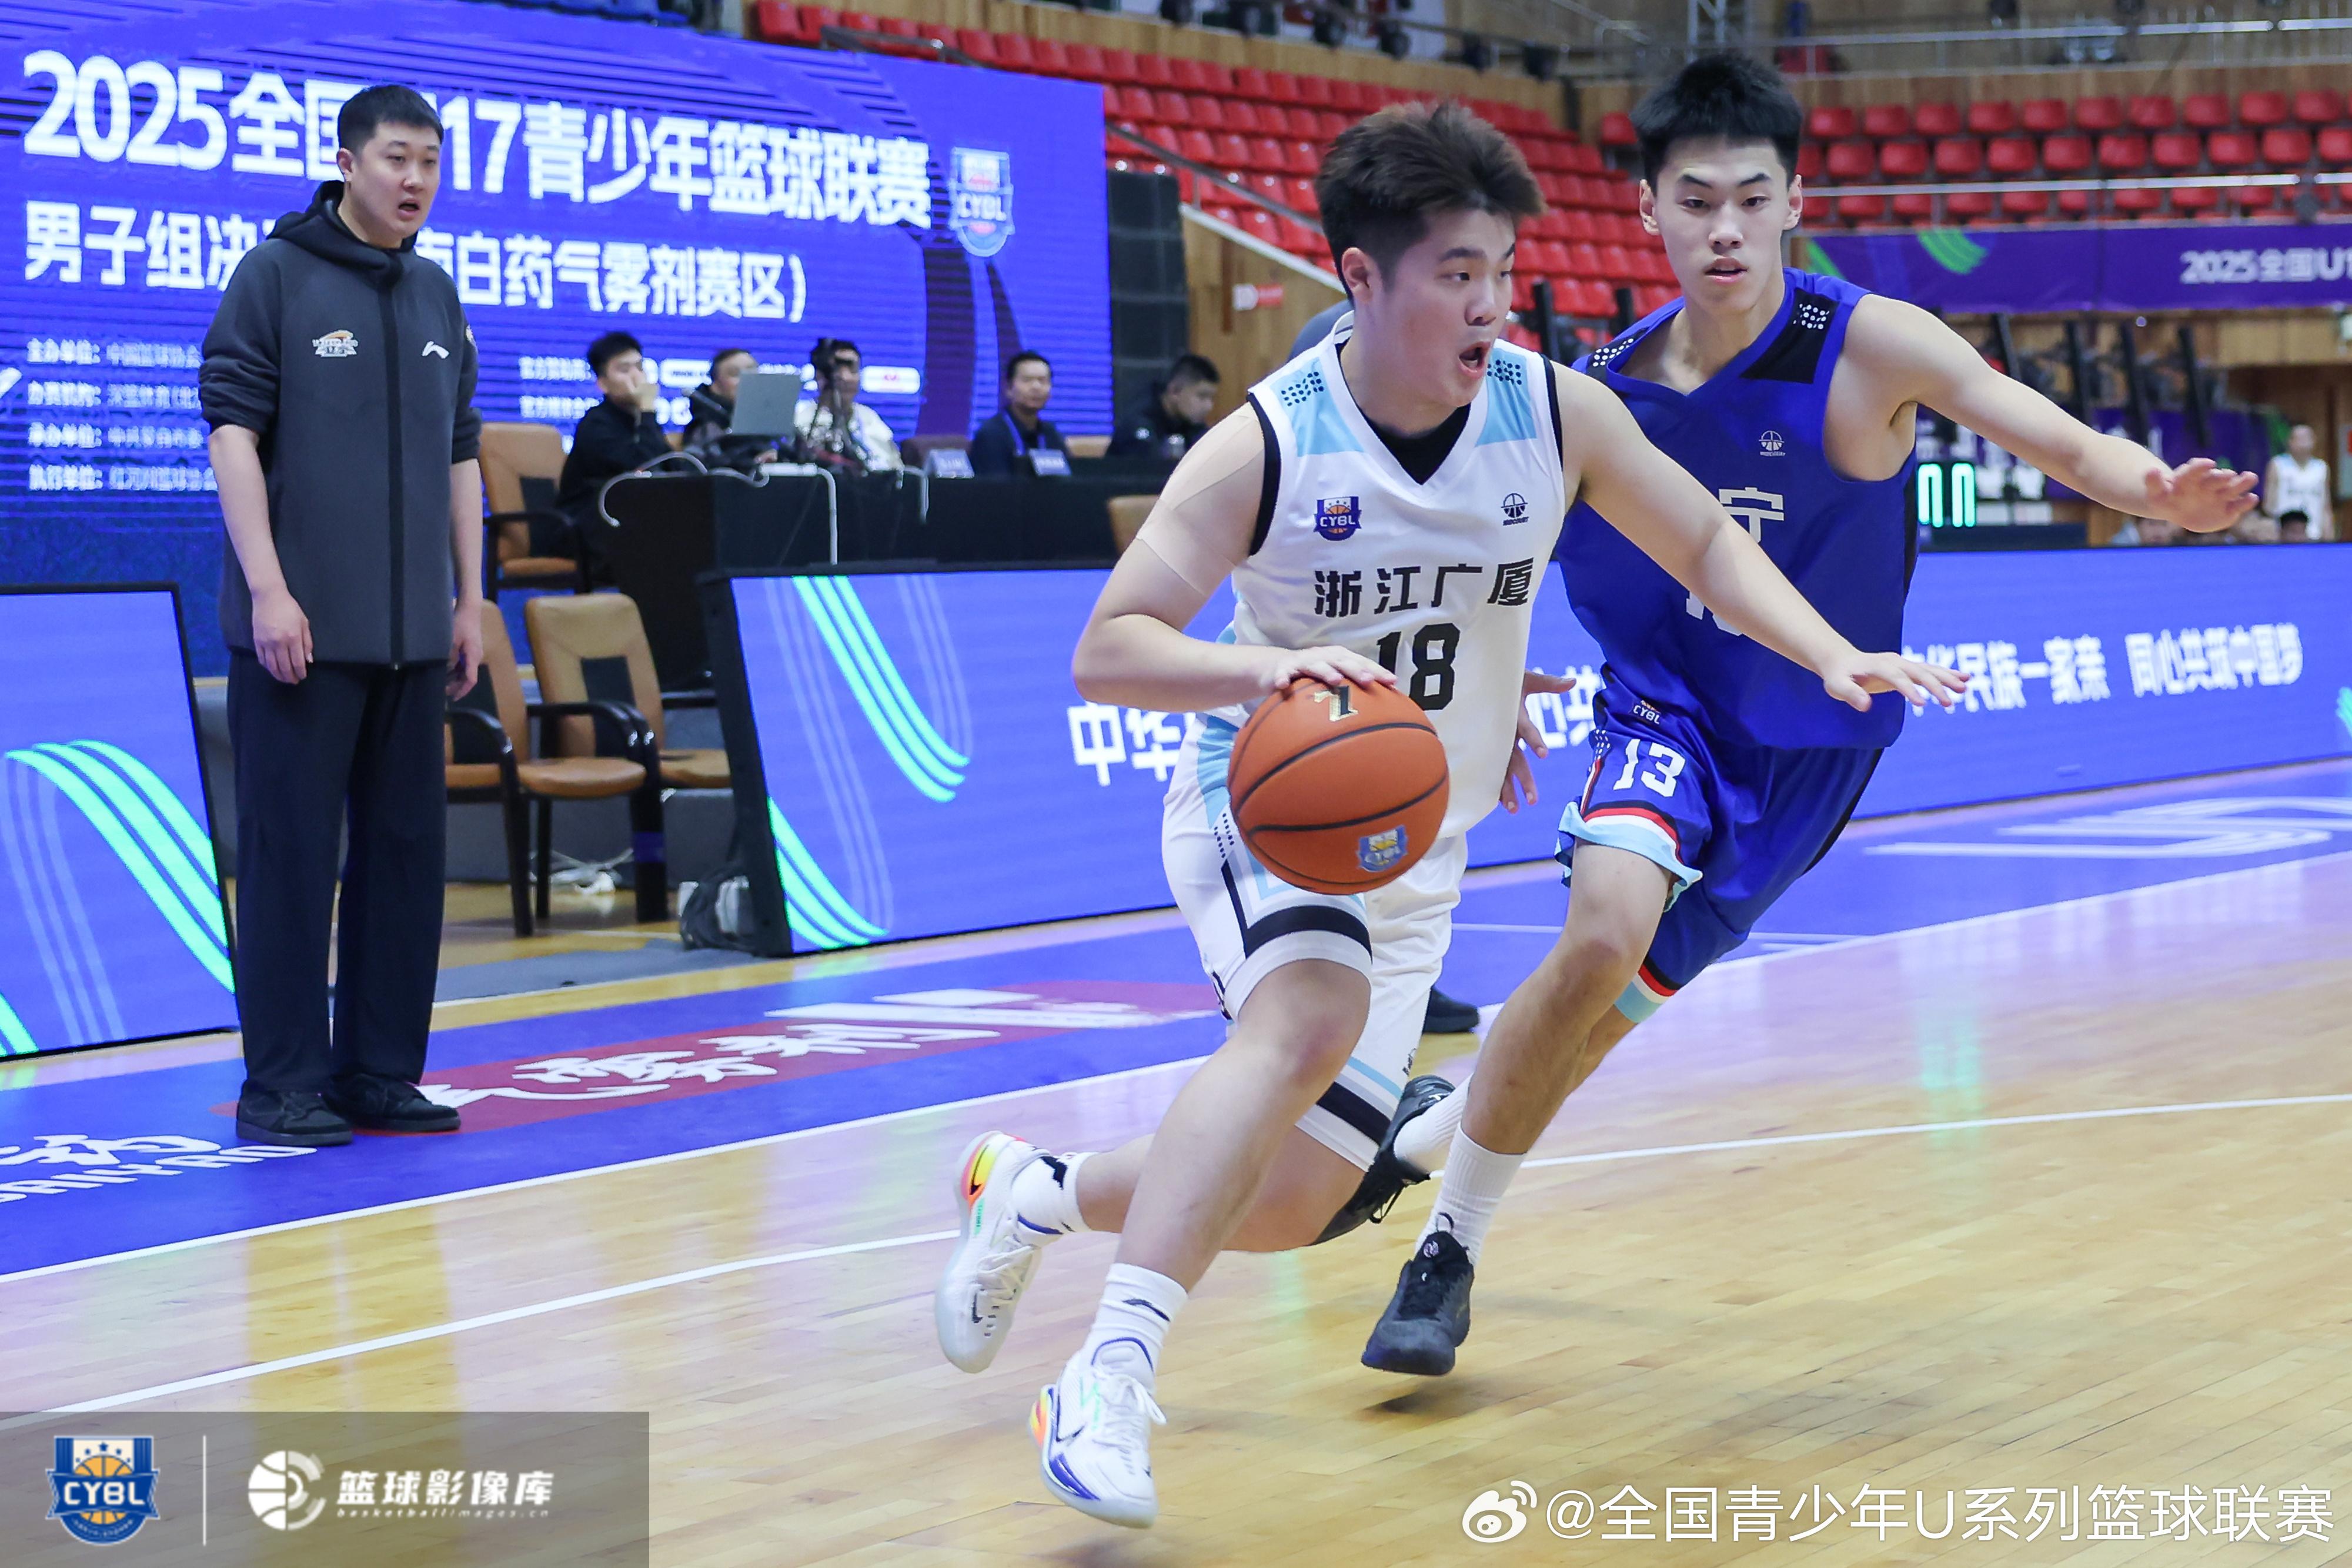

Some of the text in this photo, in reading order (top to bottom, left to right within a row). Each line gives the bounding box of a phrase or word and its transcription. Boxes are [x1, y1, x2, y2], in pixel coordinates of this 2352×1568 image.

[24, 50, 931, 228] 2025全国17青少年篮球联赛
[1320, 515, 1356, 527] CYBL
[1314, 557, 1534, 618] 浙江广厦
[1375, 623, 1461, 711] 18
[2124, 623, 2304, 698] 同心共筑中国梦
[1633, 705, 1660, 724] CYBL
[1613, 738, 1686, 797] 13
